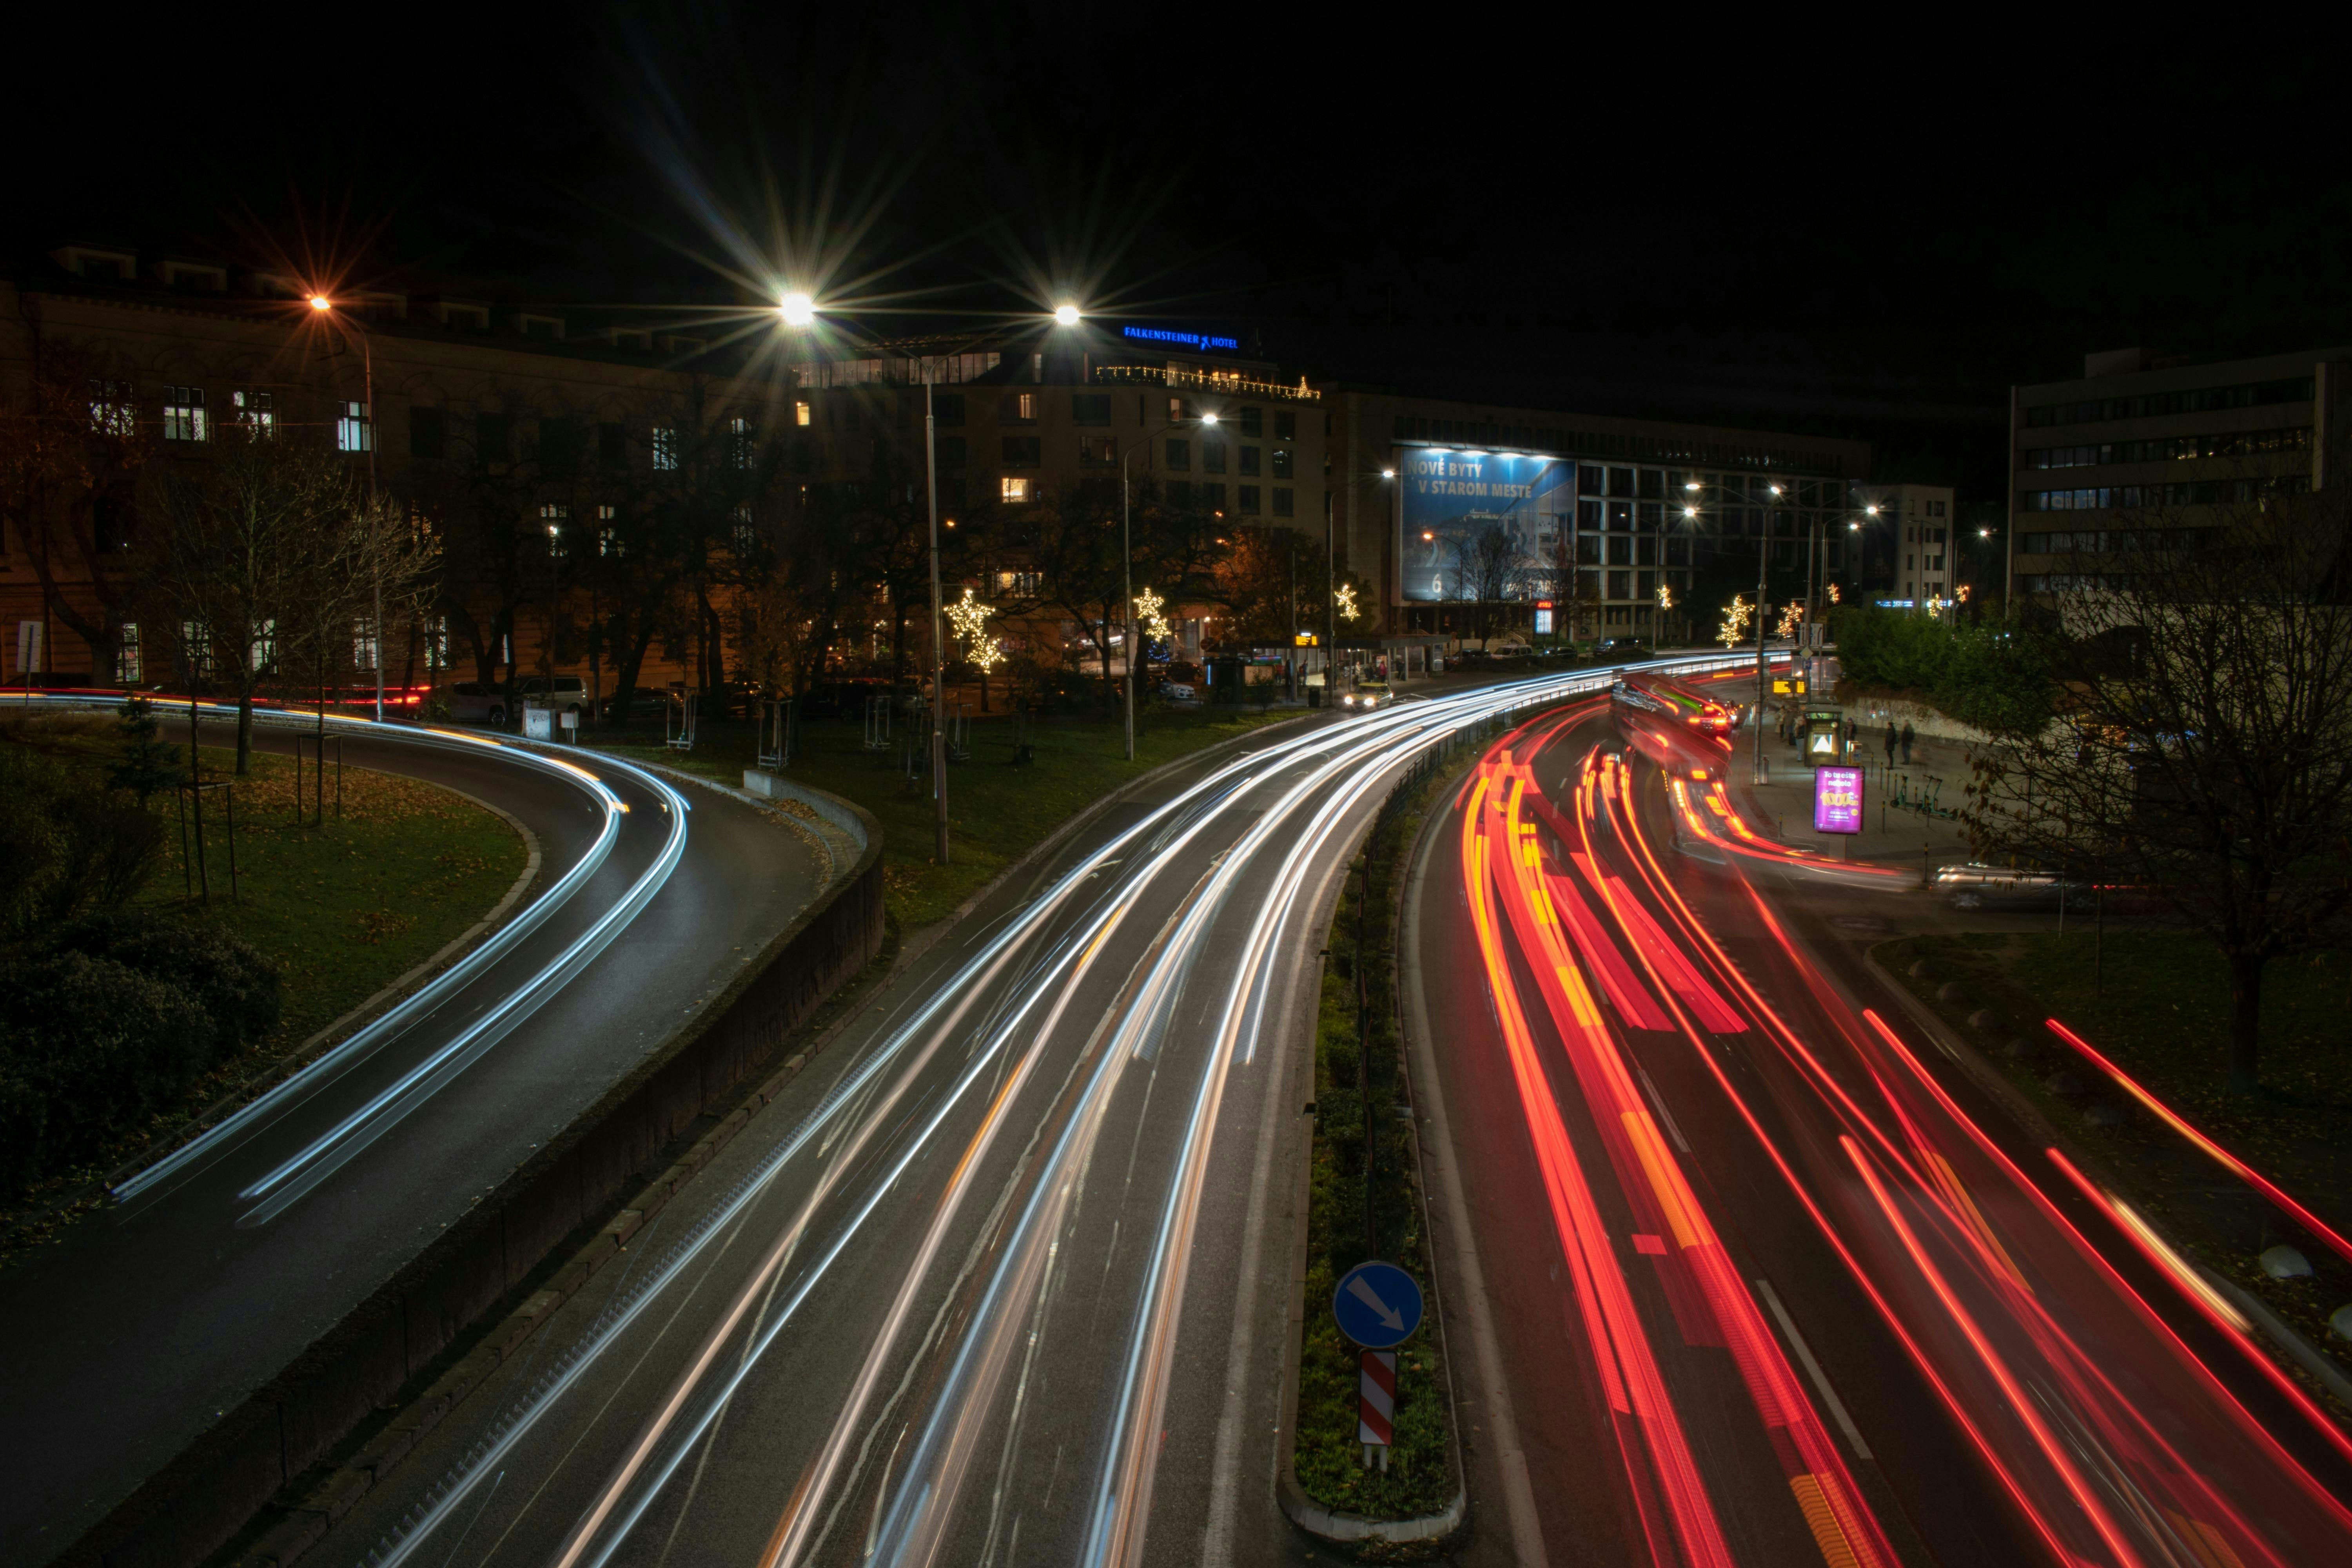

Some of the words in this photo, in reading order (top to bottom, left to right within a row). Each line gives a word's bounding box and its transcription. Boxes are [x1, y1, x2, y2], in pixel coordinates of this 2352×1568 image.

[1125, 327, 1198, 344] FALKENSTEINER
[1212, 337, 1238, 348] HOTEL
[1408, 458, 1445, 475] NOVÉ
[1449, 463, 1482, 477] BYTY
[1418, 480, 1427, 494] V
[1432, 481, 1487, 496] STAROM
[1492, 483, 1532, 498] MESTE
[1432, 573, 1441, 593] 6
